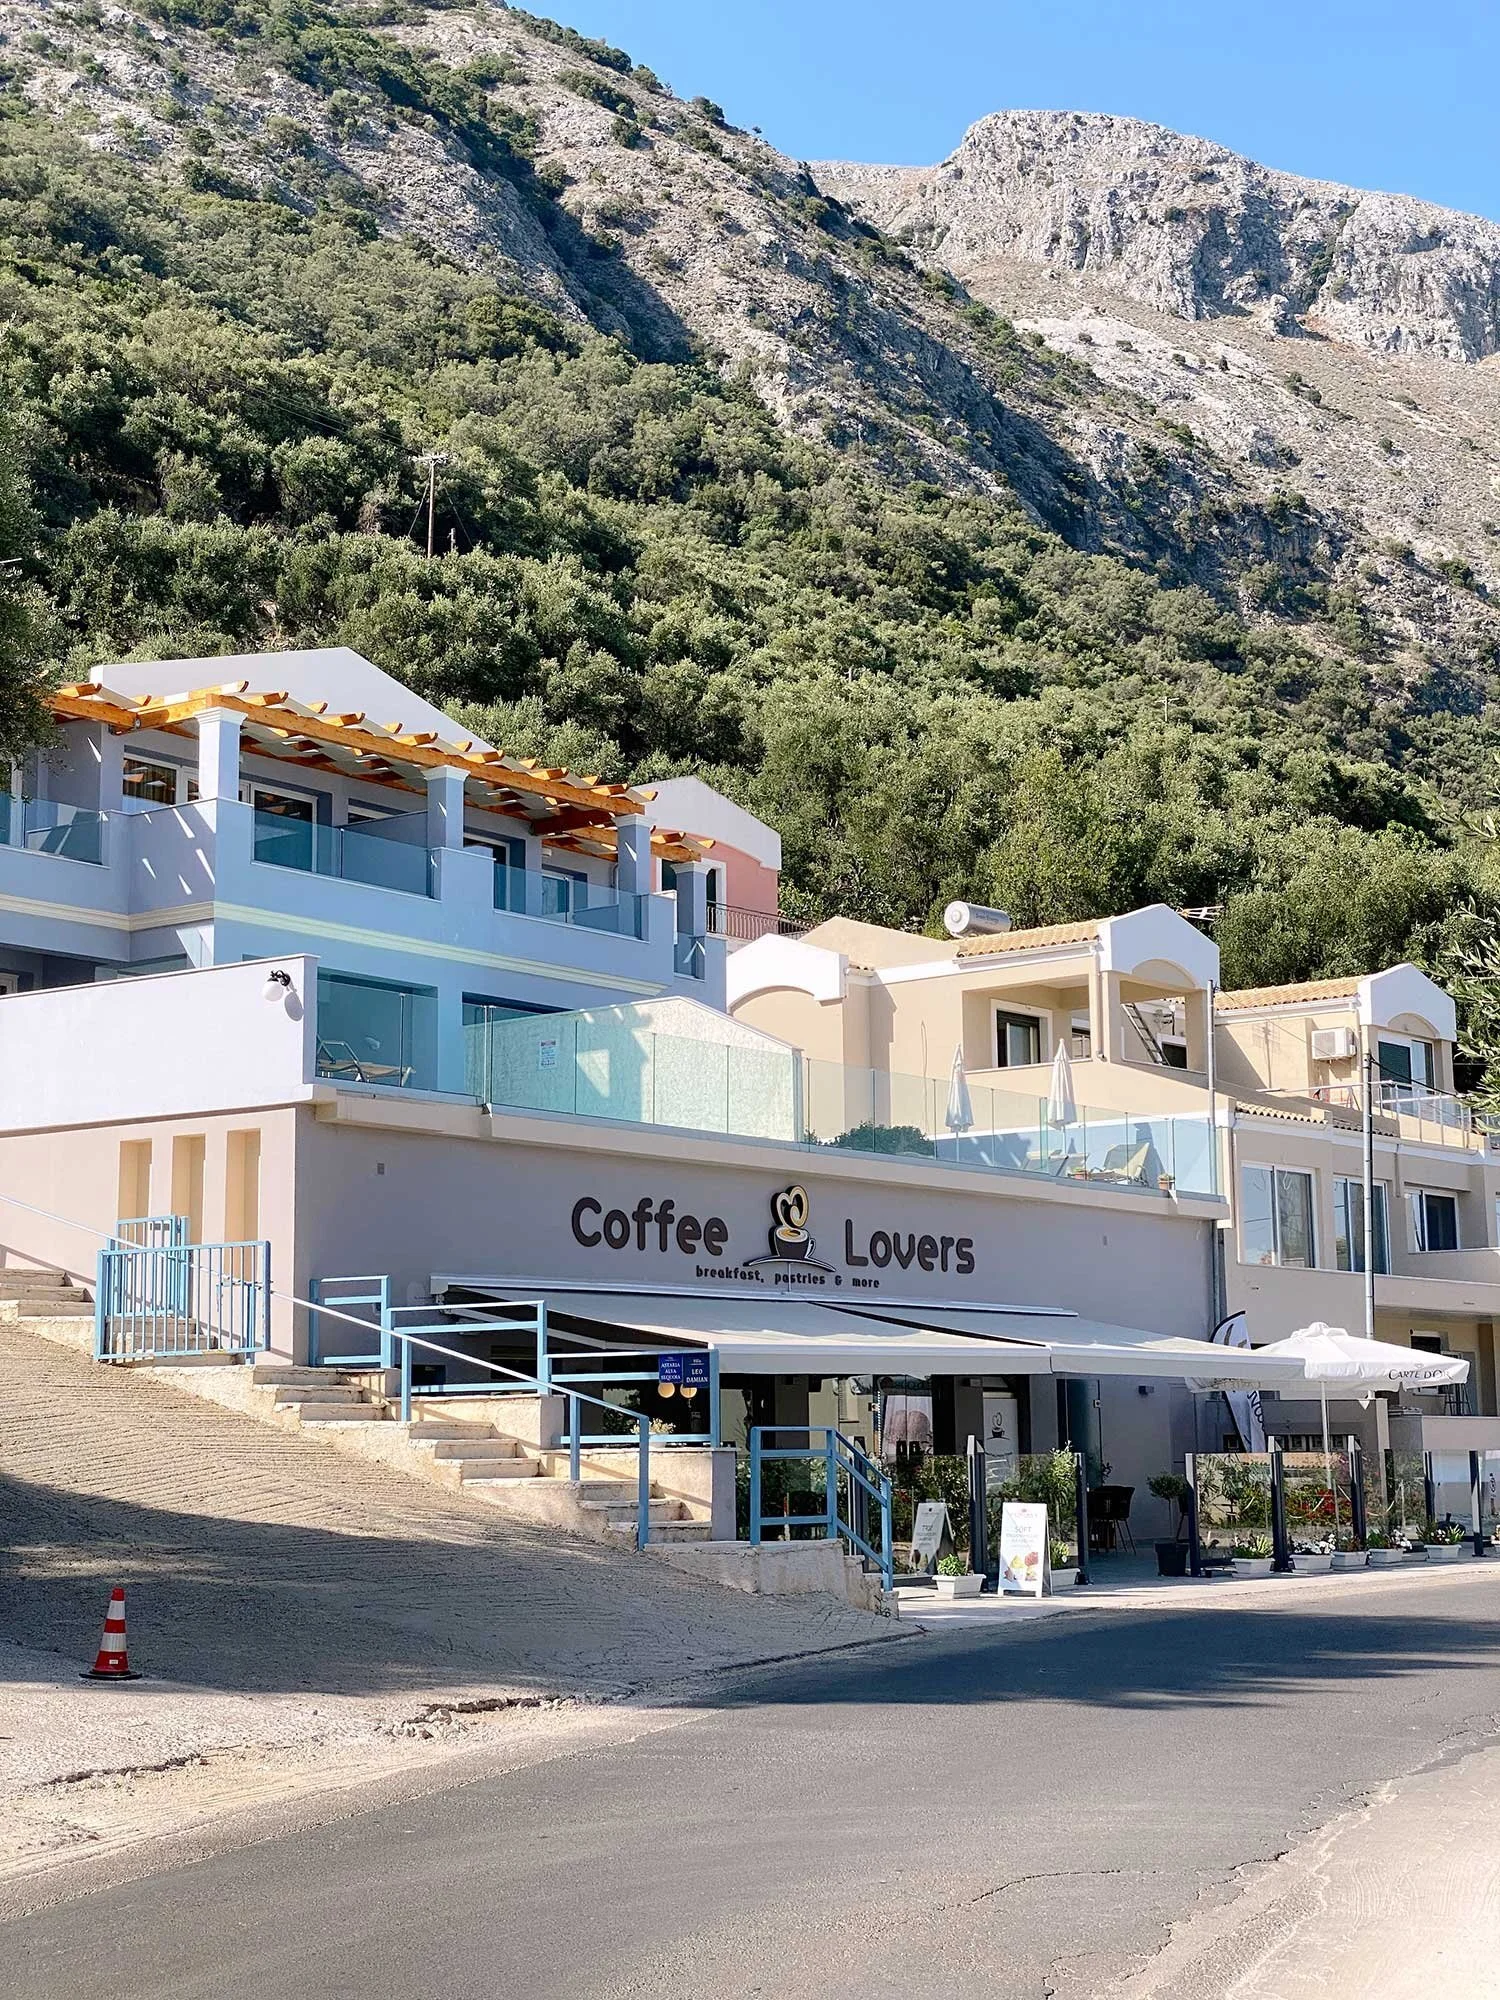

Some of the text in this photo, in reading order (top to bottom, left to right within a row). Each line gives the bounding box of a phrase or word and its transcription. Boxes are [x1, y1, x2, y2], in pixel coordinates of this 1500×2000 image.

[571, 1196, 976, 1274] Coffee Lovers
[695, 1265, 880, 1288] breakfast, pastries & more
[1388, 1368, 1420, 1381] CARTE
